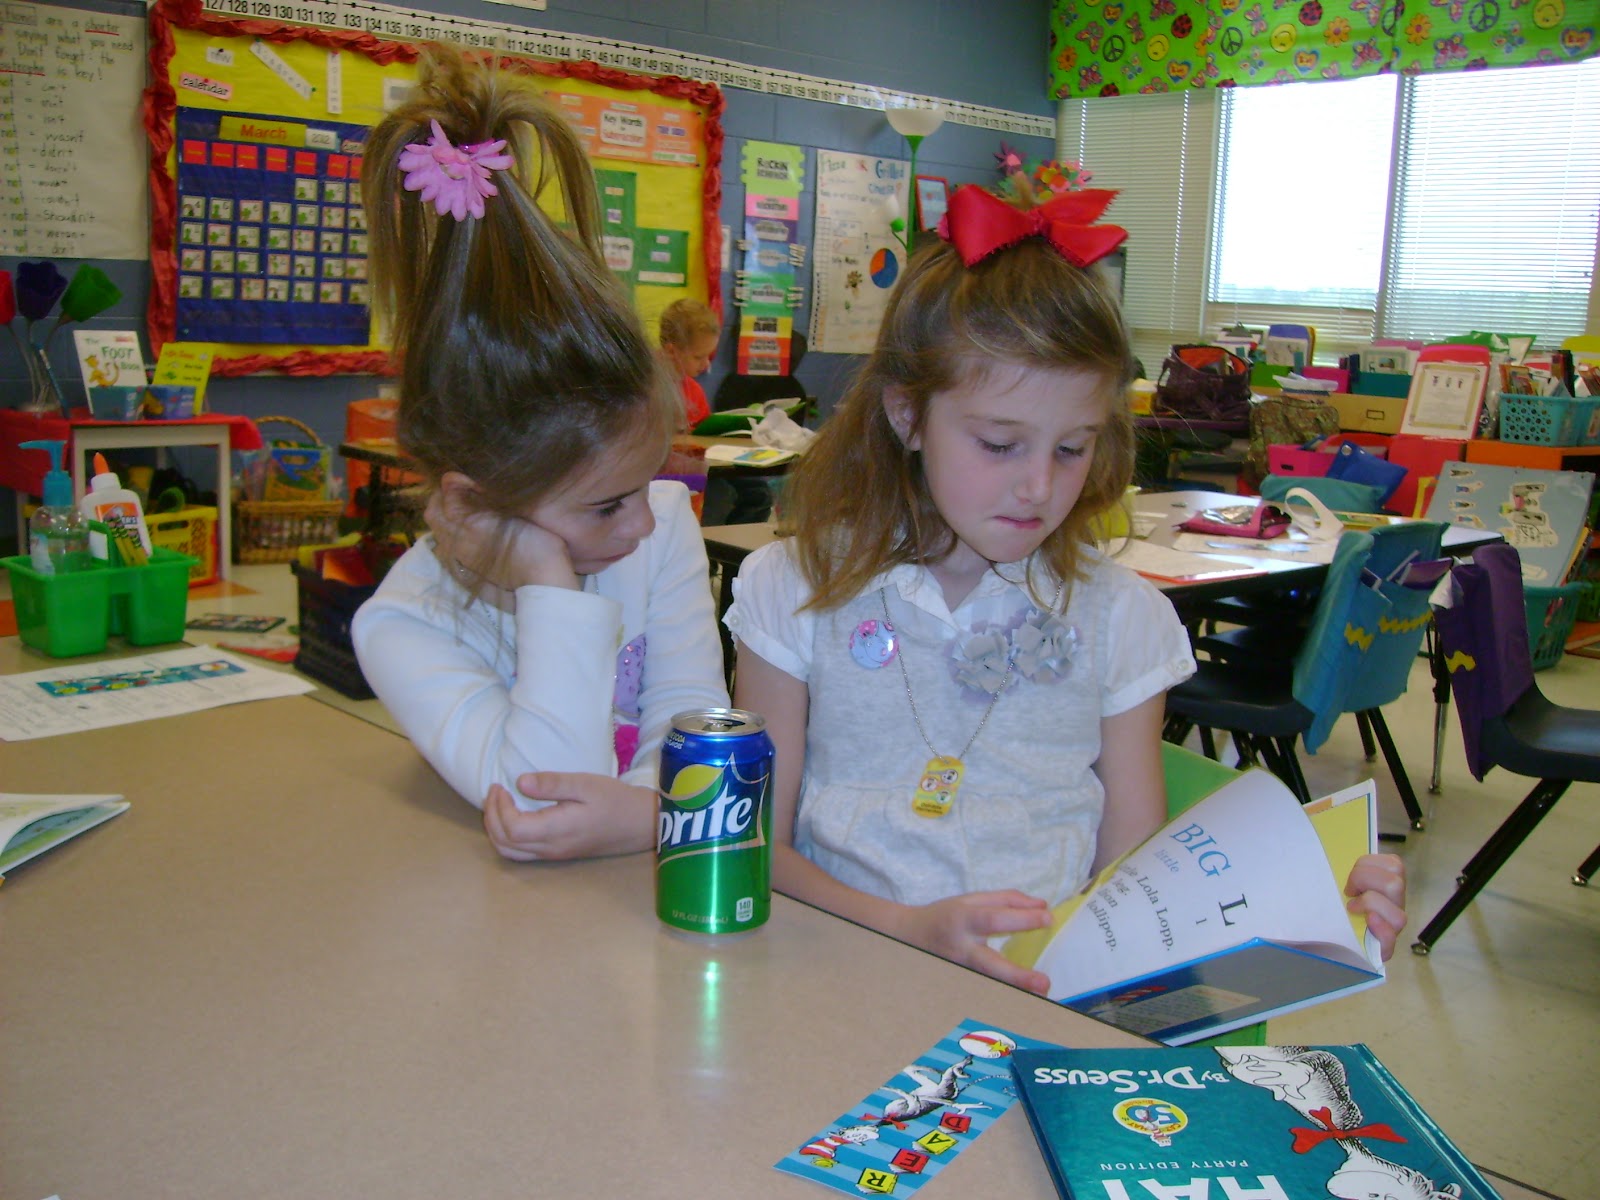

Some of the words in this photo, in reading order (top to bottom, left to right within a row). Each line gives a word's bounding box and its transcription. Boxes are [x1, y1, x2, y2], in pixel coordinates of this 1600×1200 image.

[228, 0, 248, 14] 128
[252, 3, 271, 16] 129
[274, 6, 293, 20] 130
[296, 8, 314, 22] 131
[318, 12, 336, 25] 132
[344, 14, 362, 28] 133
[364, 18, 382, 31] 134
[385, 21, 402, 34] 135
[405, 24, 422, 38] 136
[424, 26, 441, 40] 137
[444, 30, 461, 42] 138
[464, 33, 480, 46] 139
[519, 41, 535, 54] 142
[537, 43, 552, 56] 143
[554, 45, 570, 58] 144
[576, 48, 591, 60] 145
[594, 50, 608, 63] 146
[610, 53, 625, 66] 147
[627, 56, 641, 68] 148
[644, 58, 658, 71] 149
[660, 62, 674, 74] 150
[676, 64, 688, 76] 151
[690, 67, 703, 78] 152
[705, 69, 718, 82] 153
[720, 72, 734, 84] 154
[182, 76, 230, 96] calendar
[240, 124, 288, 141] March
[102, 346, 134, 359] FOOT
[657, 782, 752, 854] prite
[1153, 849, 1180, 874] little
[1169, 822, 1232, 878] BIG
[739, 900, 752, 910] 140
[1136, 876, 1160, 906] Lola
[1156, 906, 1175, 952] Lopp.
[1218, 893, 1249, 927] L
[1086, 899, 1119, 952] lollipop.
[1034, 1068, 1140, 1093] Seuss
[1140, 1066, 1206, 1090] Dr.
[1200, 1070, 1230, 1084] By
[1100, 1161, 1180, 1172] EDITION
[1192, 1160, 1249, 1169] PARTY
